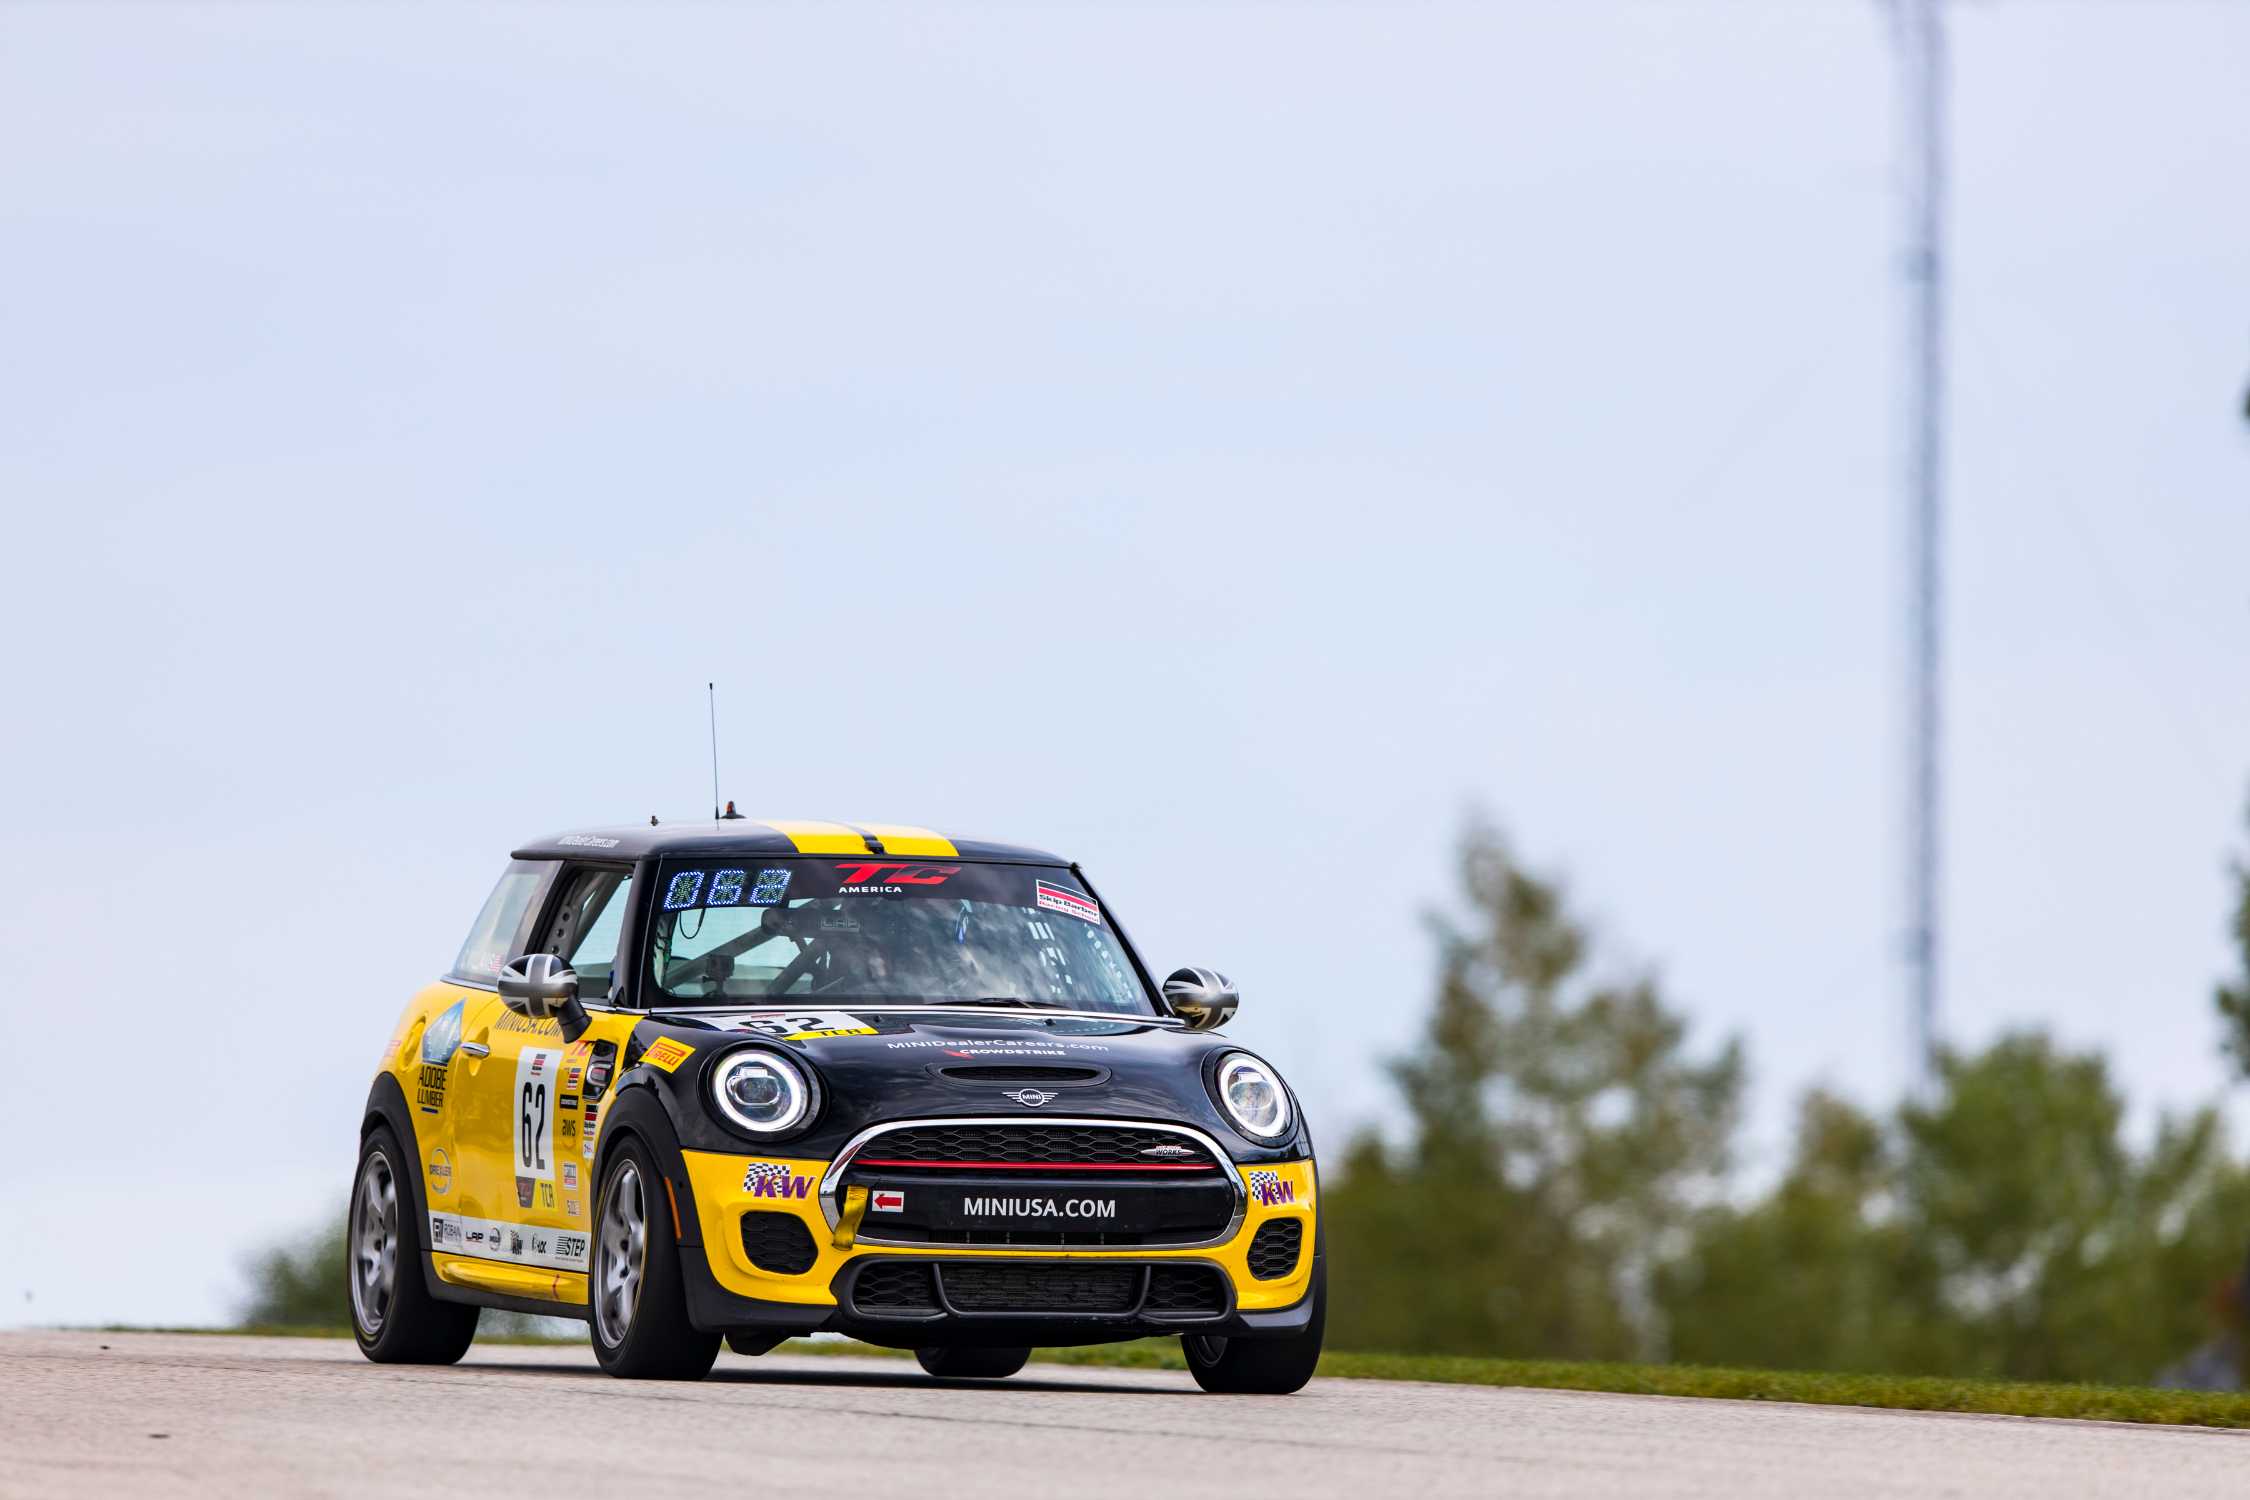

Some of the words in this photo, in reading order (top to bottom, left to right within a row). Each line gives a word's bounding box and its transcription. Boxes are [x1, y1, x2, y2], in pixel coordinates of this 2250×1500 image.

[646, 1042, 687, 1066] PIRELLI
[887, 1039, 1109, 1052] MINIDealerCareers.com
[418, 1065, 447, 1090] ADOBE
[416, 1088, 443, 1107] LUMBER
[1022, 1093, 1041, 1101] MINI
[522, 1082, 546, 1170] 62
[562, 1119, 576, 1136] aws
[753, 1175, 817, 1199] KW
[1260, 1180, 1295, 1206] KW
[963, 1197, 1116, 1218] MINIUSA.COM
[566, 1236, 586, 1257] STEP
